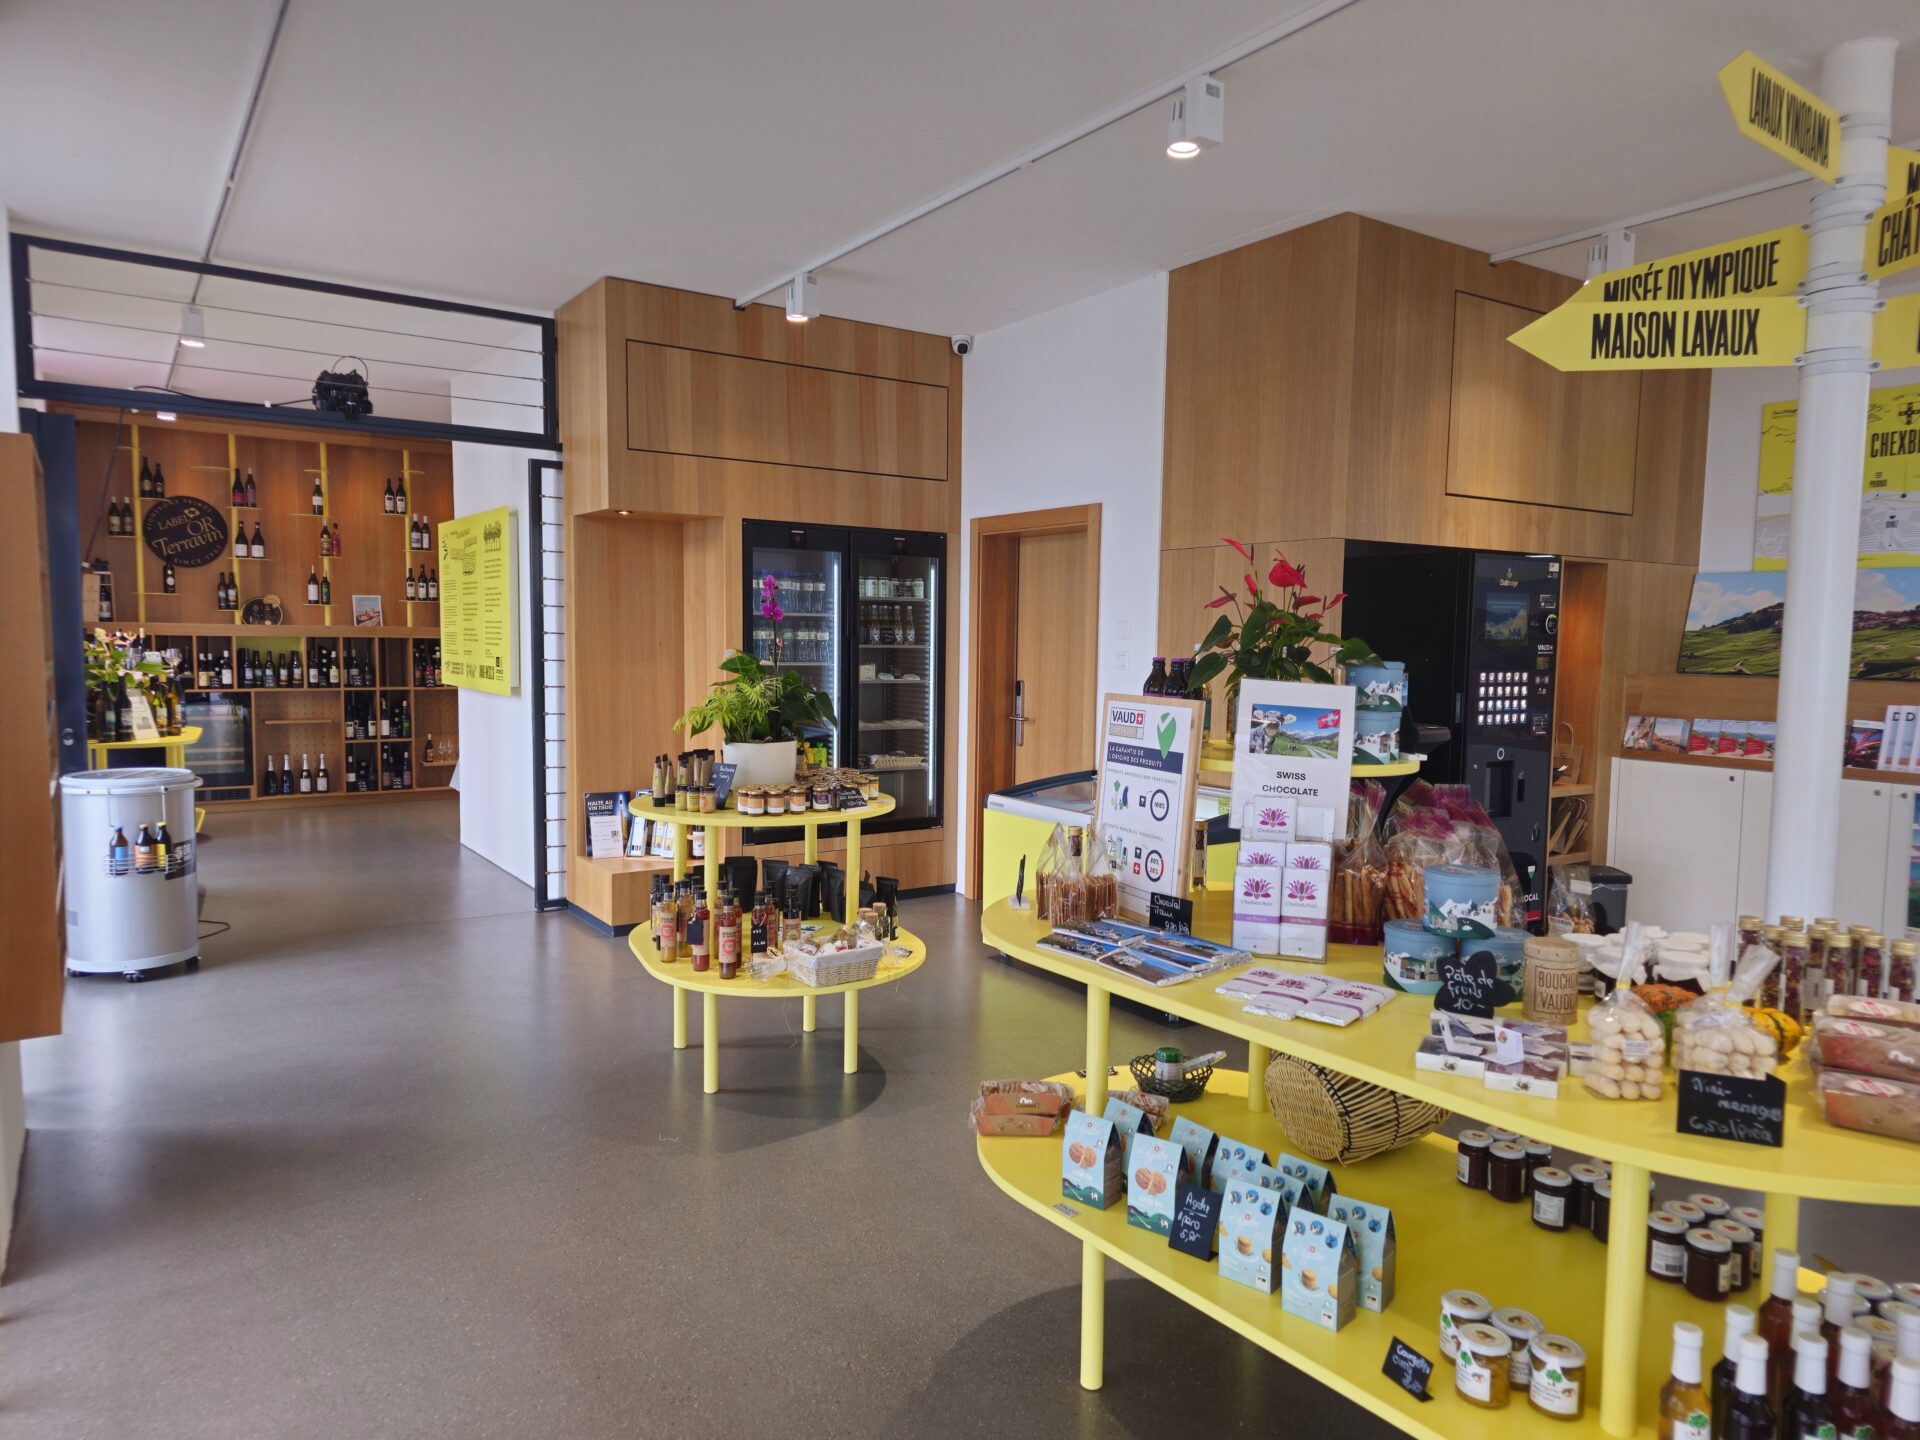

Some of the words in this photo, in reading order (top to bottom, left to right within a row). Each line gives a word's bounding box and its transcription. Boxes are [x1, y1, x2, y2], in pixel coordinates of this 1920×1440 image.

[1749, 67, 1785, 141] LAVAUX
[1785, 90, 1831, 169] VINORAMA
[1603, 262, 1664, 302] MUSÉE
[1666, 239, 1781, 300] OLYMPIQUE
[1591, 310, 1677, 360] MAISON
[1681, 308, 1760, 357] LAVAUX
[1870, 428, 1920, 458] CHEXB
[159, 514, 189, 530] LABEL
[187, 517, 216, 536] OR
[152, 529, 224, 557] Terravin
[1112, 710, 1136, 724] VAUD
[1139, 758, 1162, 767] PRODUITS
[1276, 771, 1306, 780] SWISS
[1262, 785, 1319, 796] CHOCOLATE
[1154, 895, 1181, 910] Chocolat
[1522, 893, 1539, 902] OCAL
[1444, 965, 1474, 984] Pâte
[1477, 970, 1494, 988] de
